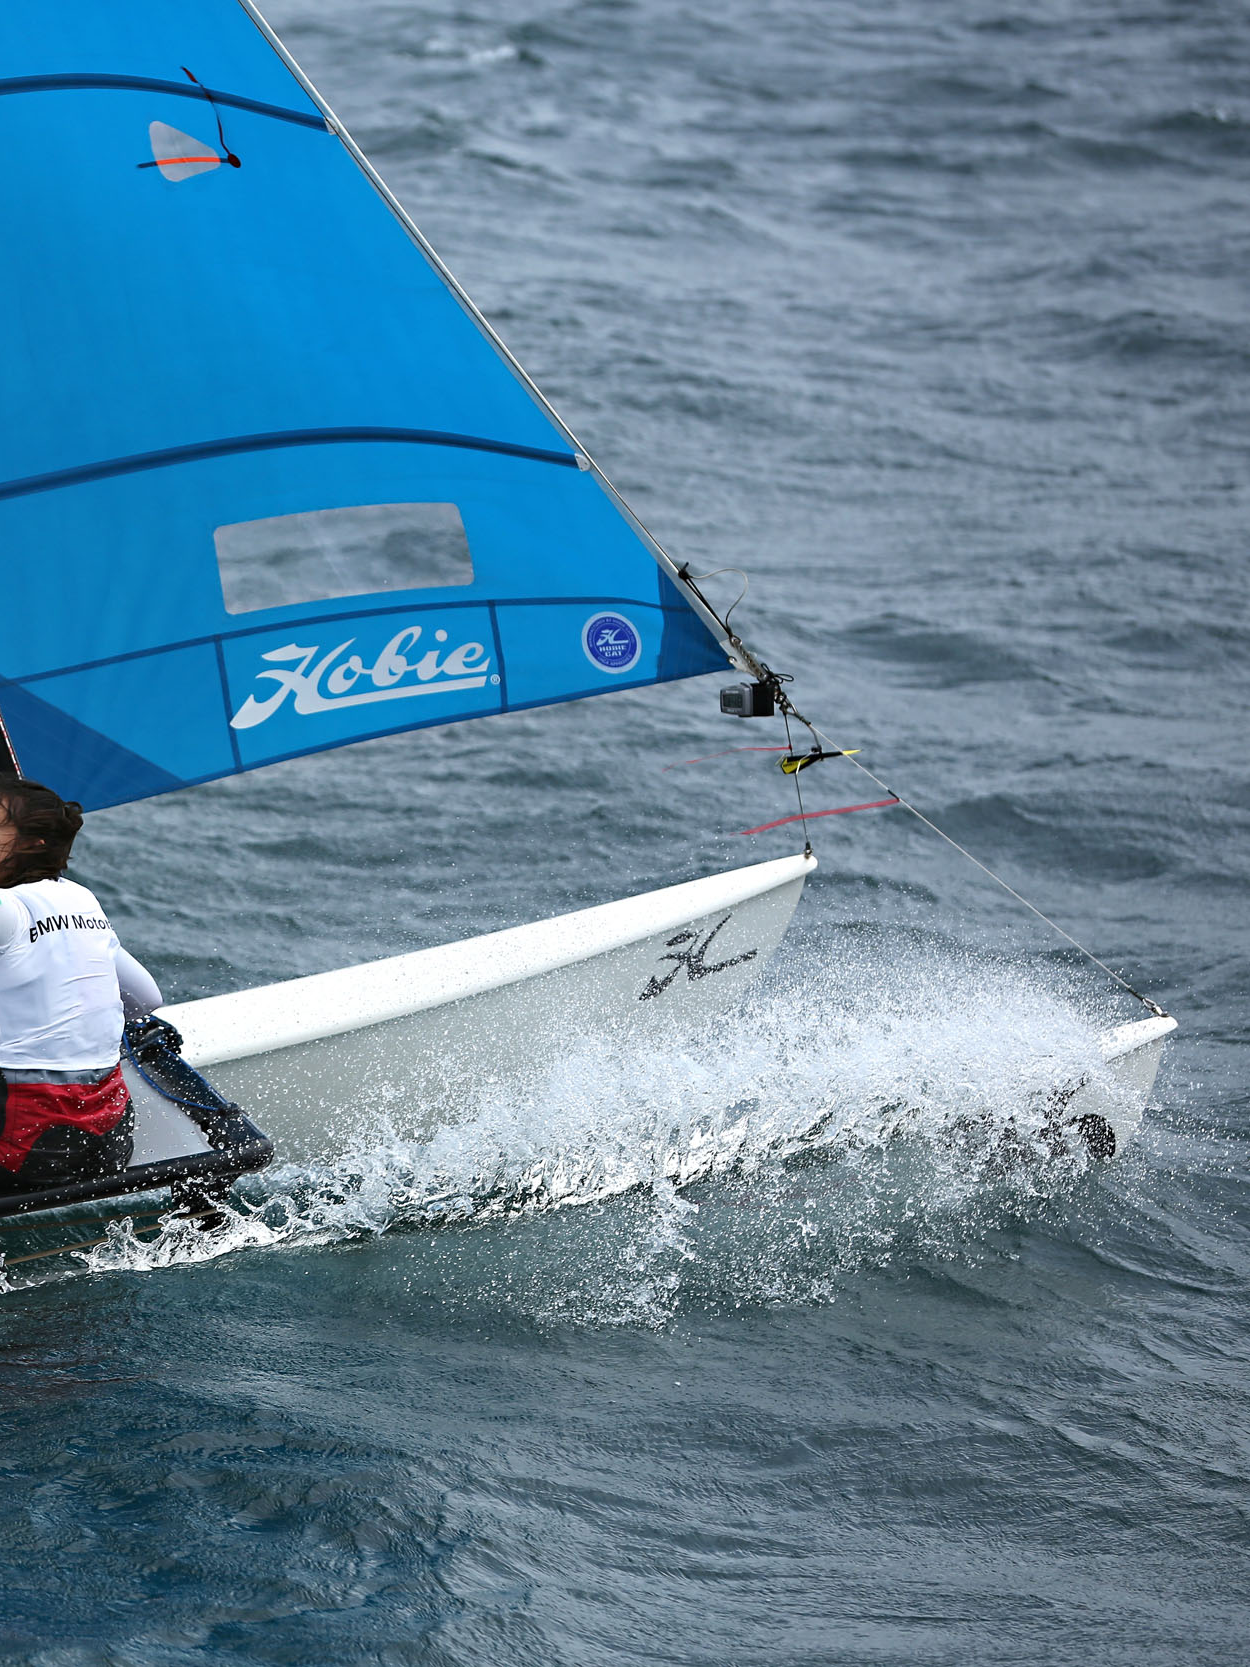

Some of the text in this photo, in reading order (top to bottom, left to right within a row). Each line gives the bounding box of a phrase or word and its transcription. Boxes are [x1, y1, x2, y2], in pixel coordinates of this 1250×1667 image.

[230, 626, 491, 729] Hobie
[29, 914, 114, 944] BMW Motor
